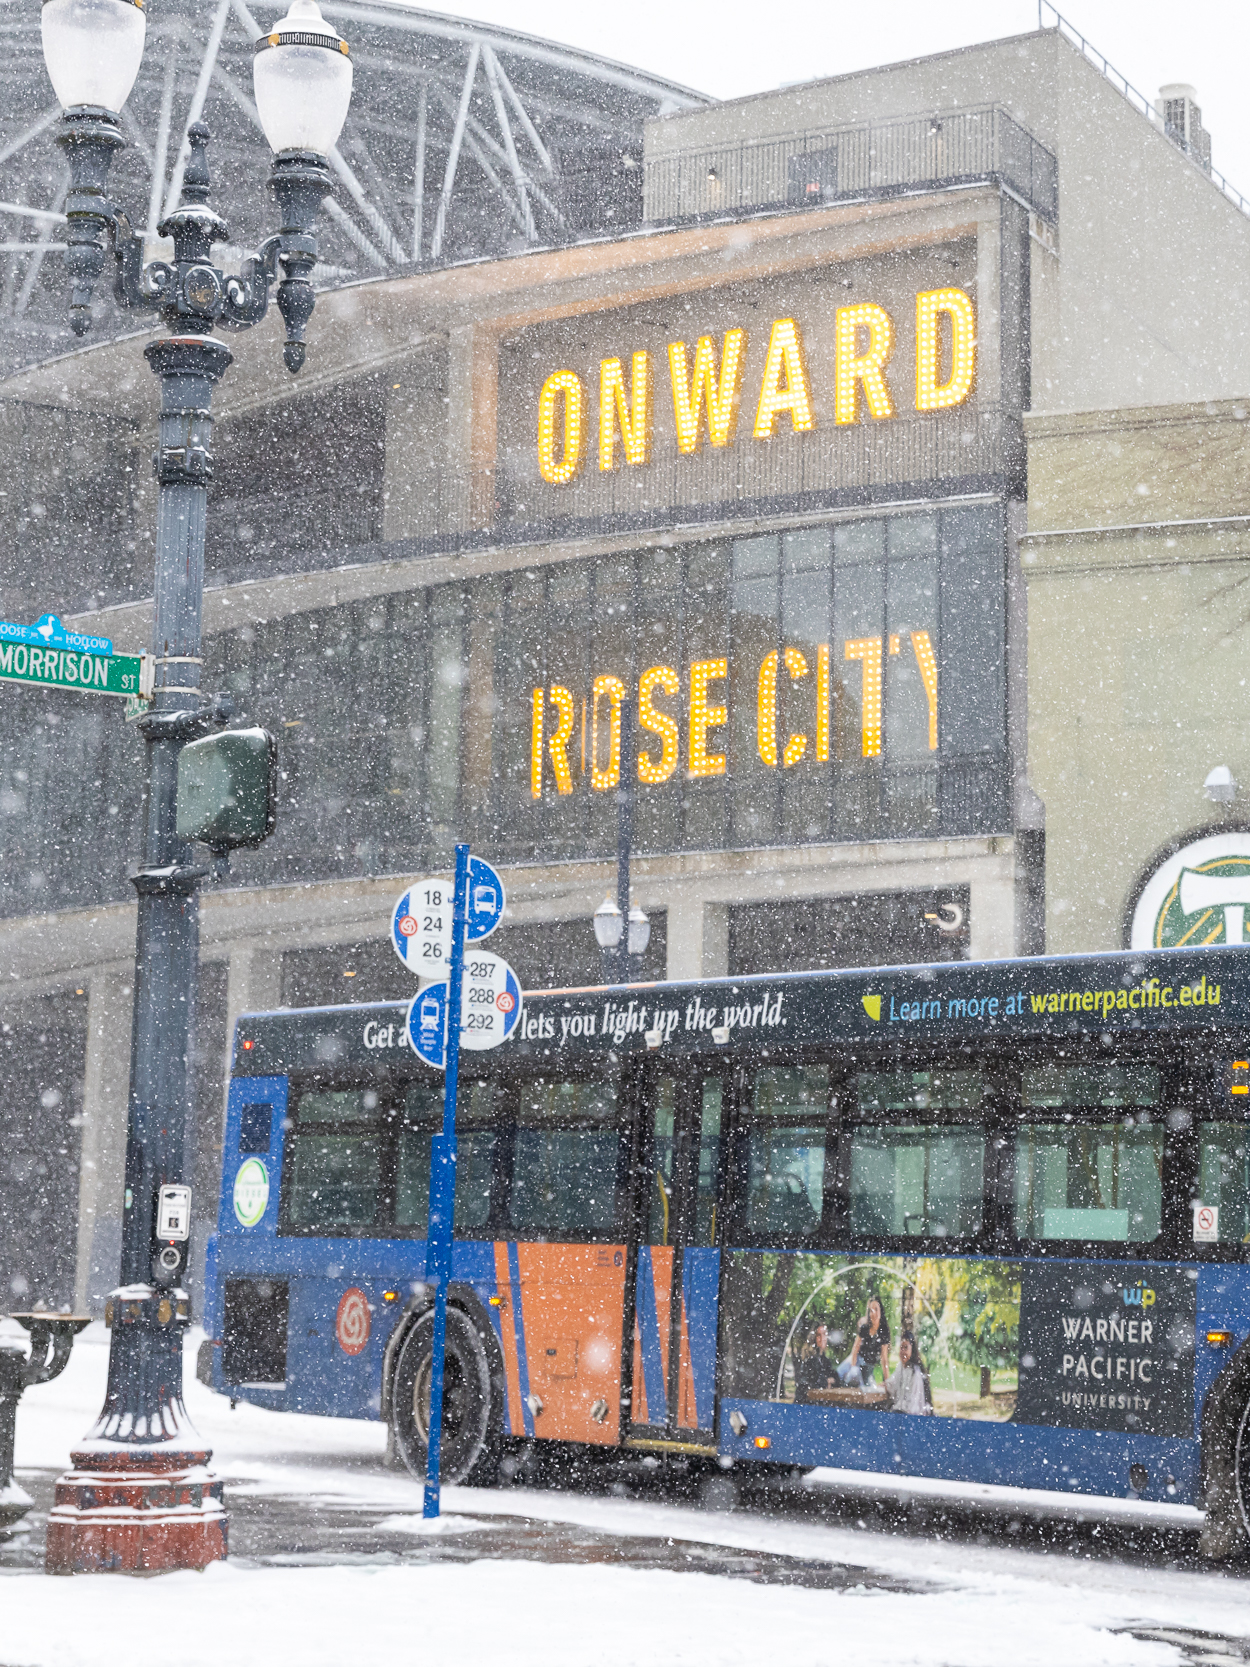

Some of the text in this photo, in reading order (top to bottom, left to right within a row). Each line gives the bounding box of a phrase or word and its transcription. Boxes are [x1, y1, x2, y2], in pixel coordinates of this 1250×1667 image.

[537, 287, 978, 484] ONWARD
[0, 623, 109, 650] OOSE HOLLOW
[0, 642, 136, 689] MORRISON ST
[530, 630, 940, 800] ROSE CITY
[424, 890, 442, 906] 18
[423, 916, 443, 932] 24
[422, 942, 443, 958] 26
[470, 962, 496, 979] 287
[468, 988, 495, 1005] 288
[890, 975, 1221, 1021] Learn more at warnerpacific.edu
[467, 1013, 494, 1031] 292
[521, 991, 789, 1047] lets you light up the world.
[363, 1020, 389, 1050] Get
[1062, 1316, 1153, 1344] WARNER
[1062, 1354, 1152, 1382] PACIFIC
[1062, 1391, 1151, 1411] UNIVERSITY
